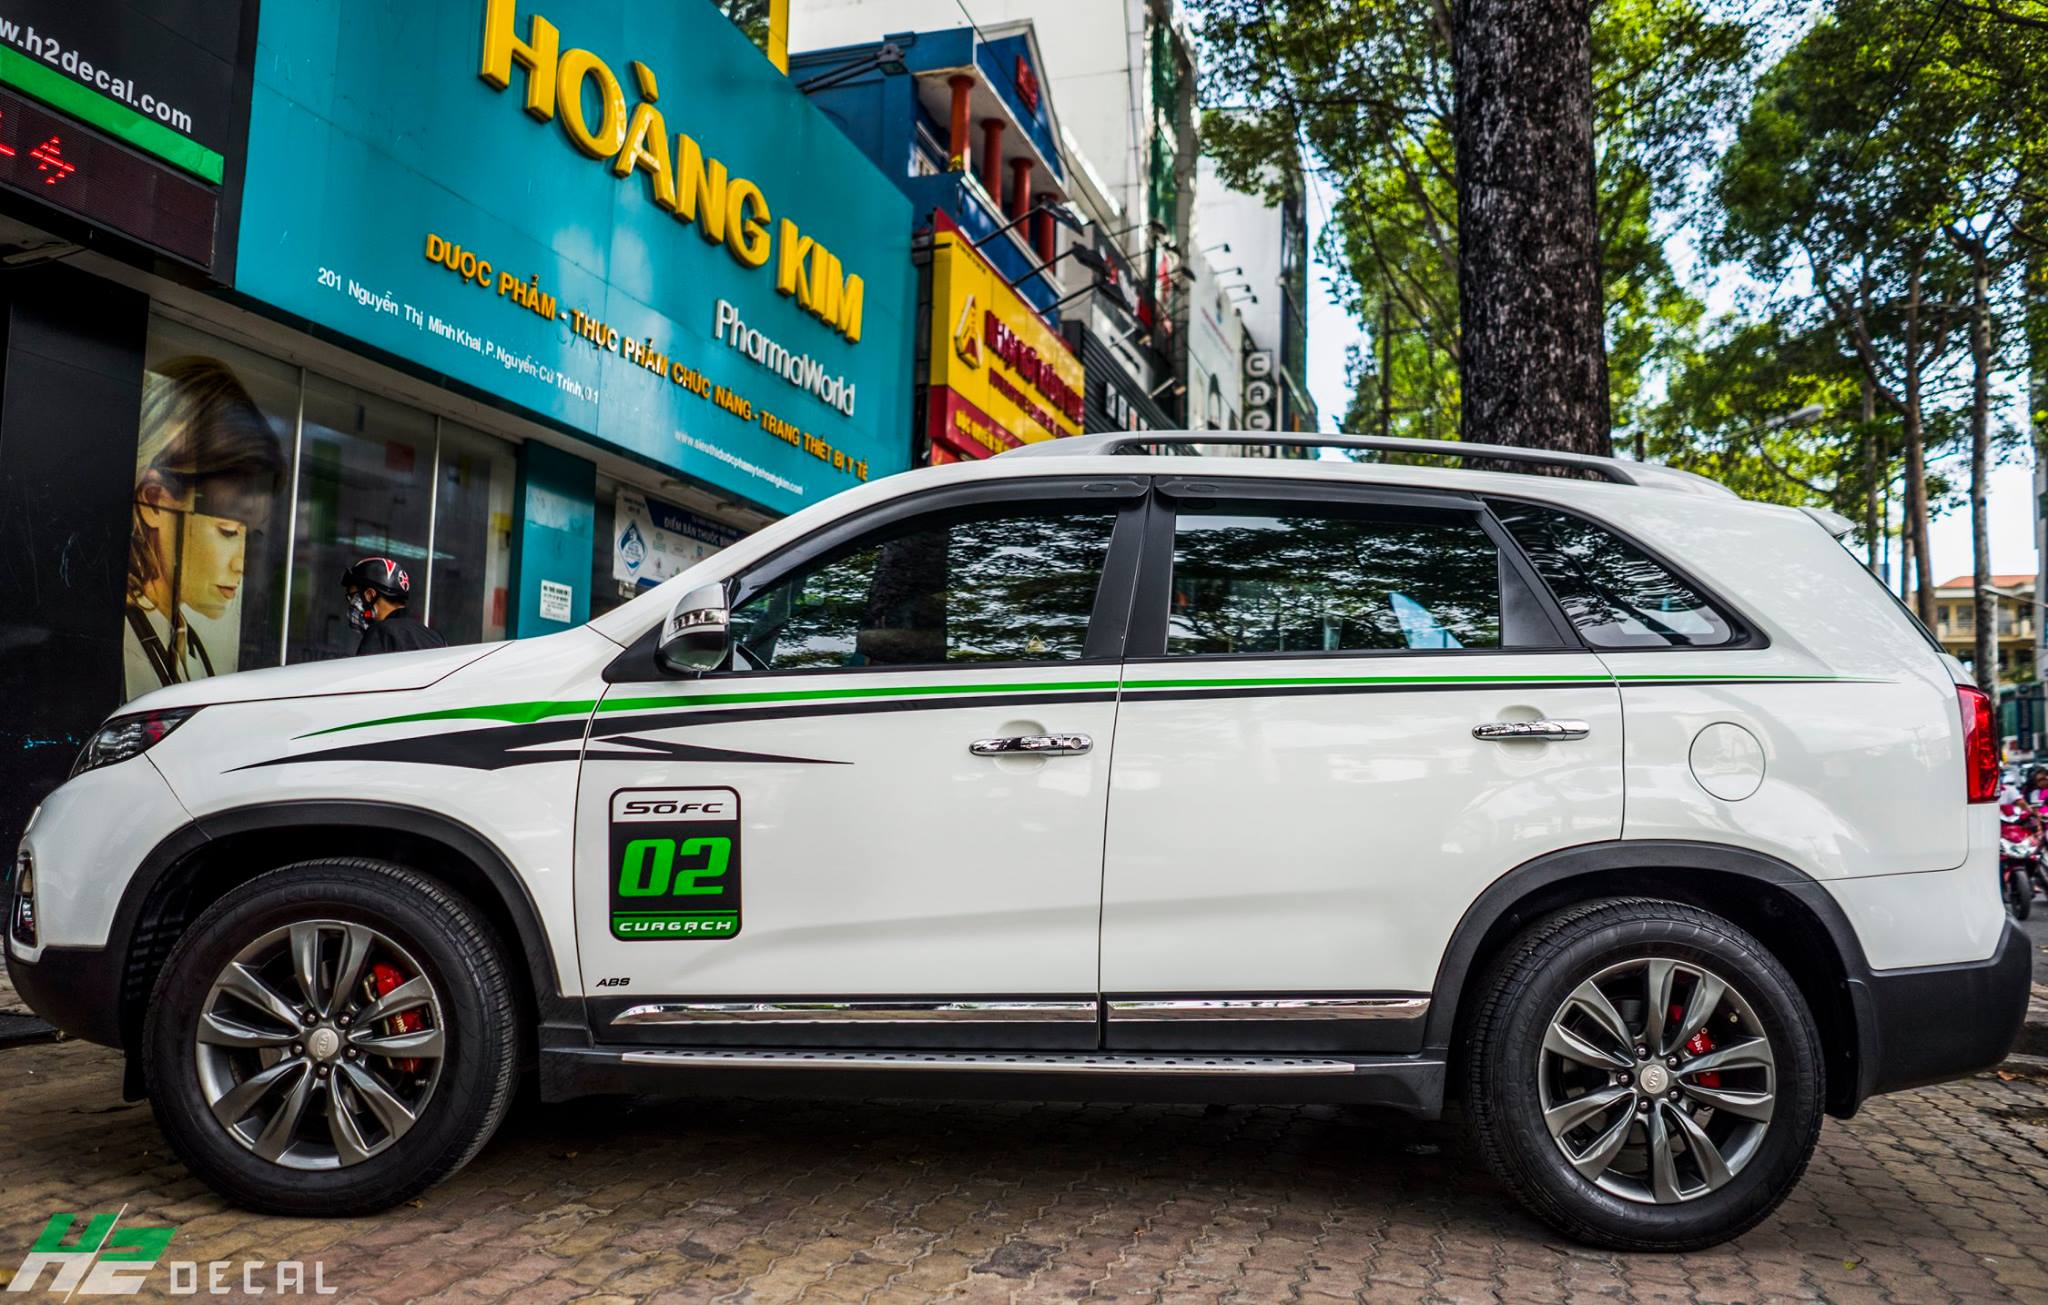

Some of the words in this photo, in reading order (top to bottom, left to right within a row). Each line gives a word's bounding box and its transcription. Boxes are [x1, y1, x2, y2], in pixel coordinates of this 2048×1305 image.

[479, 0, 772, 269] HOÀNG
[777, 217, 865, 344] KIM
[317, 266, 342, 292] 201
[348, 278, 399, 317] Nguyễn
[403, 303, 424, 331] Thị
[497, 273, 557, 321] PHẨM
[760, 410, 801, 447] TRANG
[714, 298, 856, 417] PharmaWorld
[618, 836, 732, 898] 02
[595, 977, 631, 988] ABS
